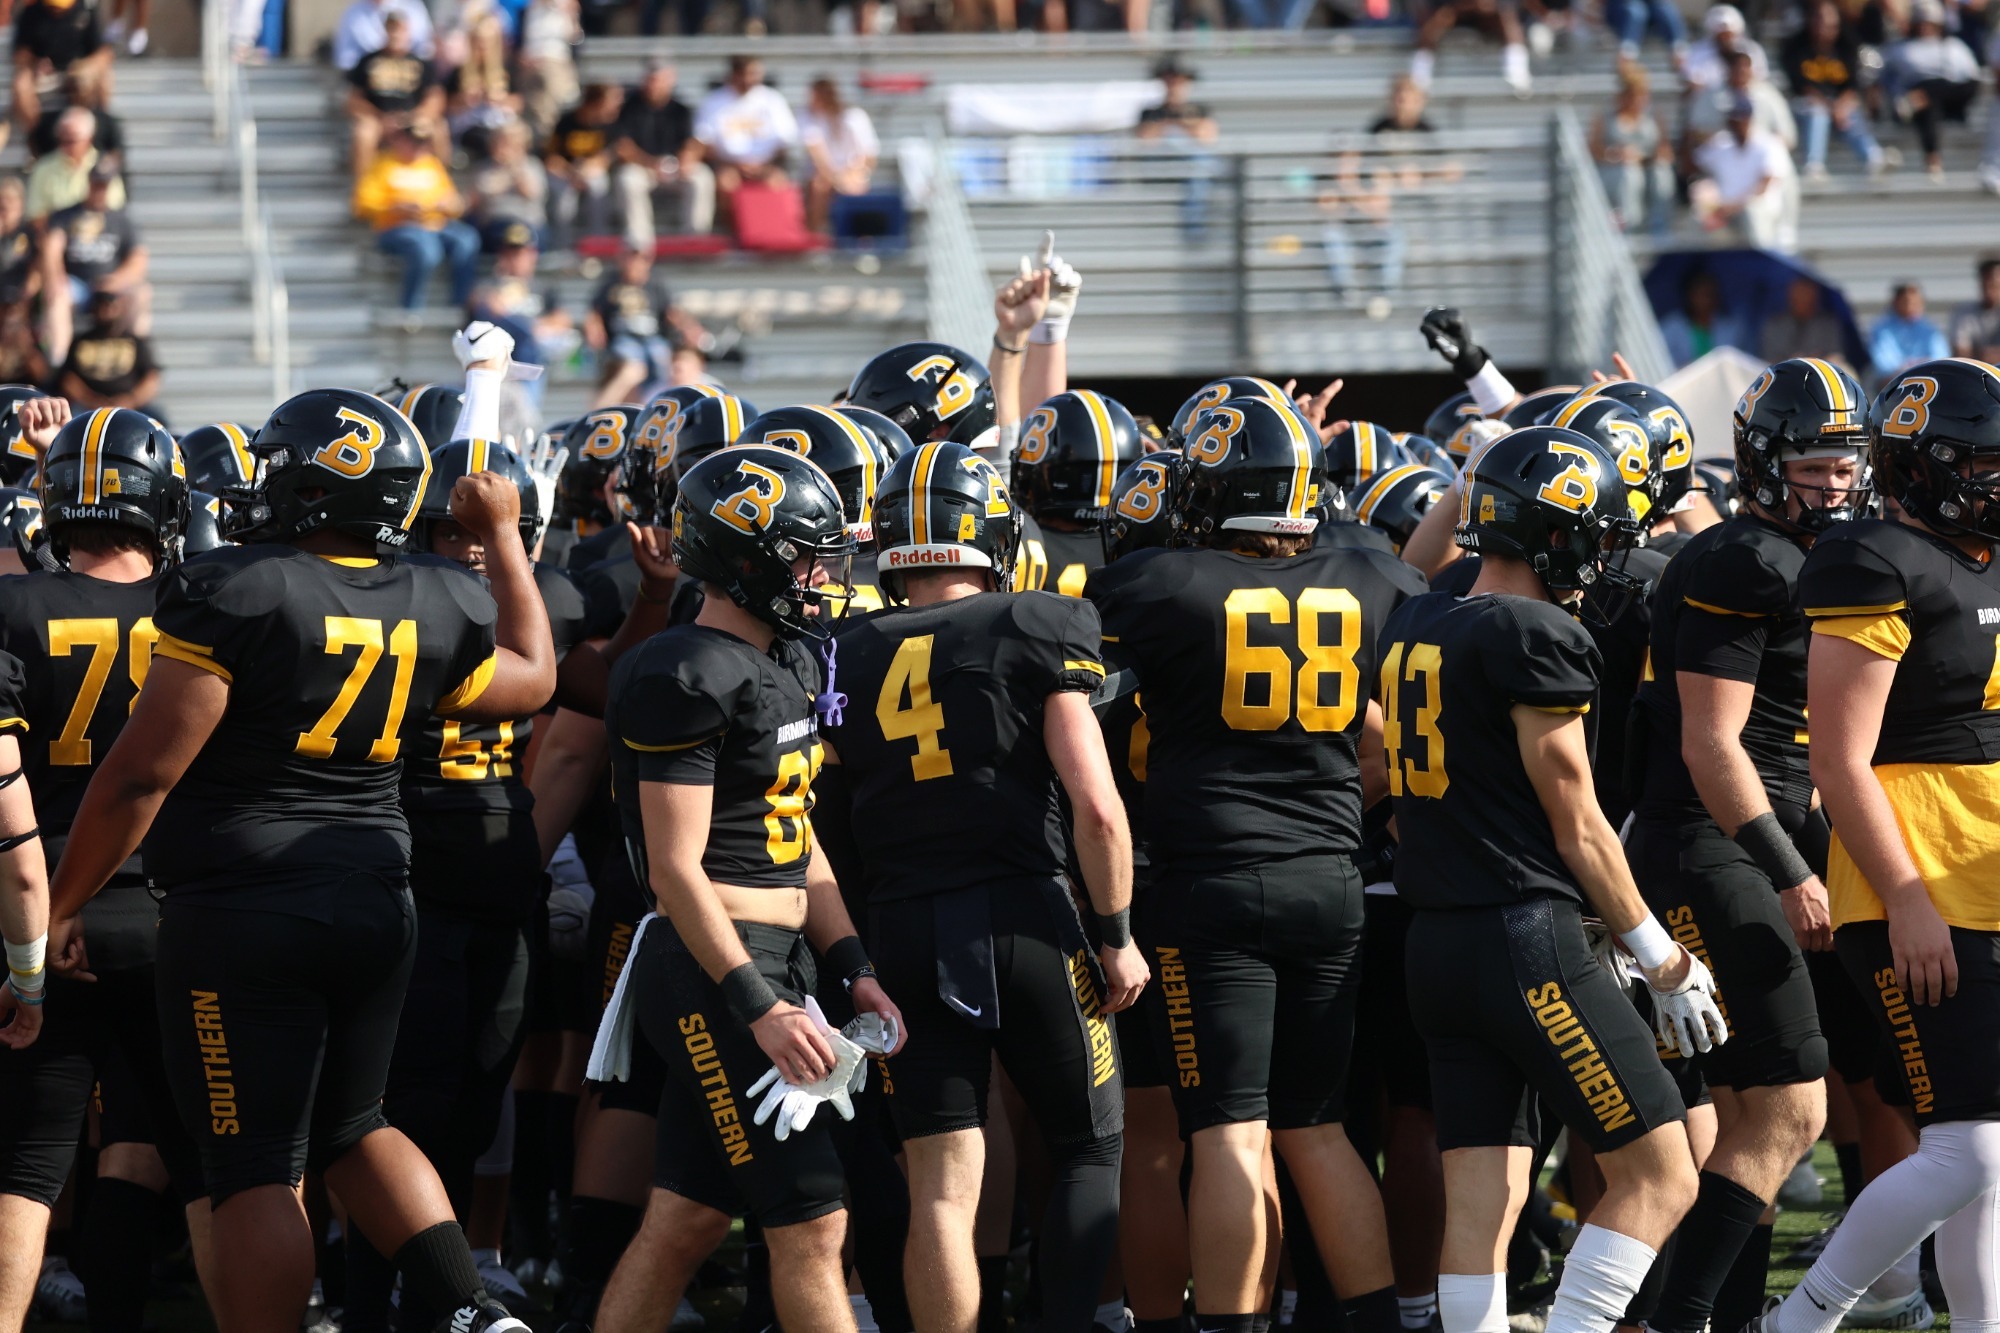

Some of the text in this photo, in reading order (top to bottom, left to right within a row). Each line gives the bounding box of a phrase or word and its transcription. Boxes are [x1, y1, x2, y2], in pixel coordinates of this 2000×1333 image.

[61, 506, 120, 520] Riddell
[889, 548, 961, 566] Riddell
[295, 615, 418, 763] 71
[875, 633, 954, 782] 4
[1221, 587, 1361, 732] 68
[1381, 642, 1450, 799] 43
[191, 989, 240, 1135] SOUTHERN
[678, 1012, 753, 1166] SOUTHERN
[1156, 947, 1201, 1088] SOUTHERN
[1526, 981, 1636, 1133] SOUTHERN
[1875, 967, 1934, 1113] SOUTHERN
